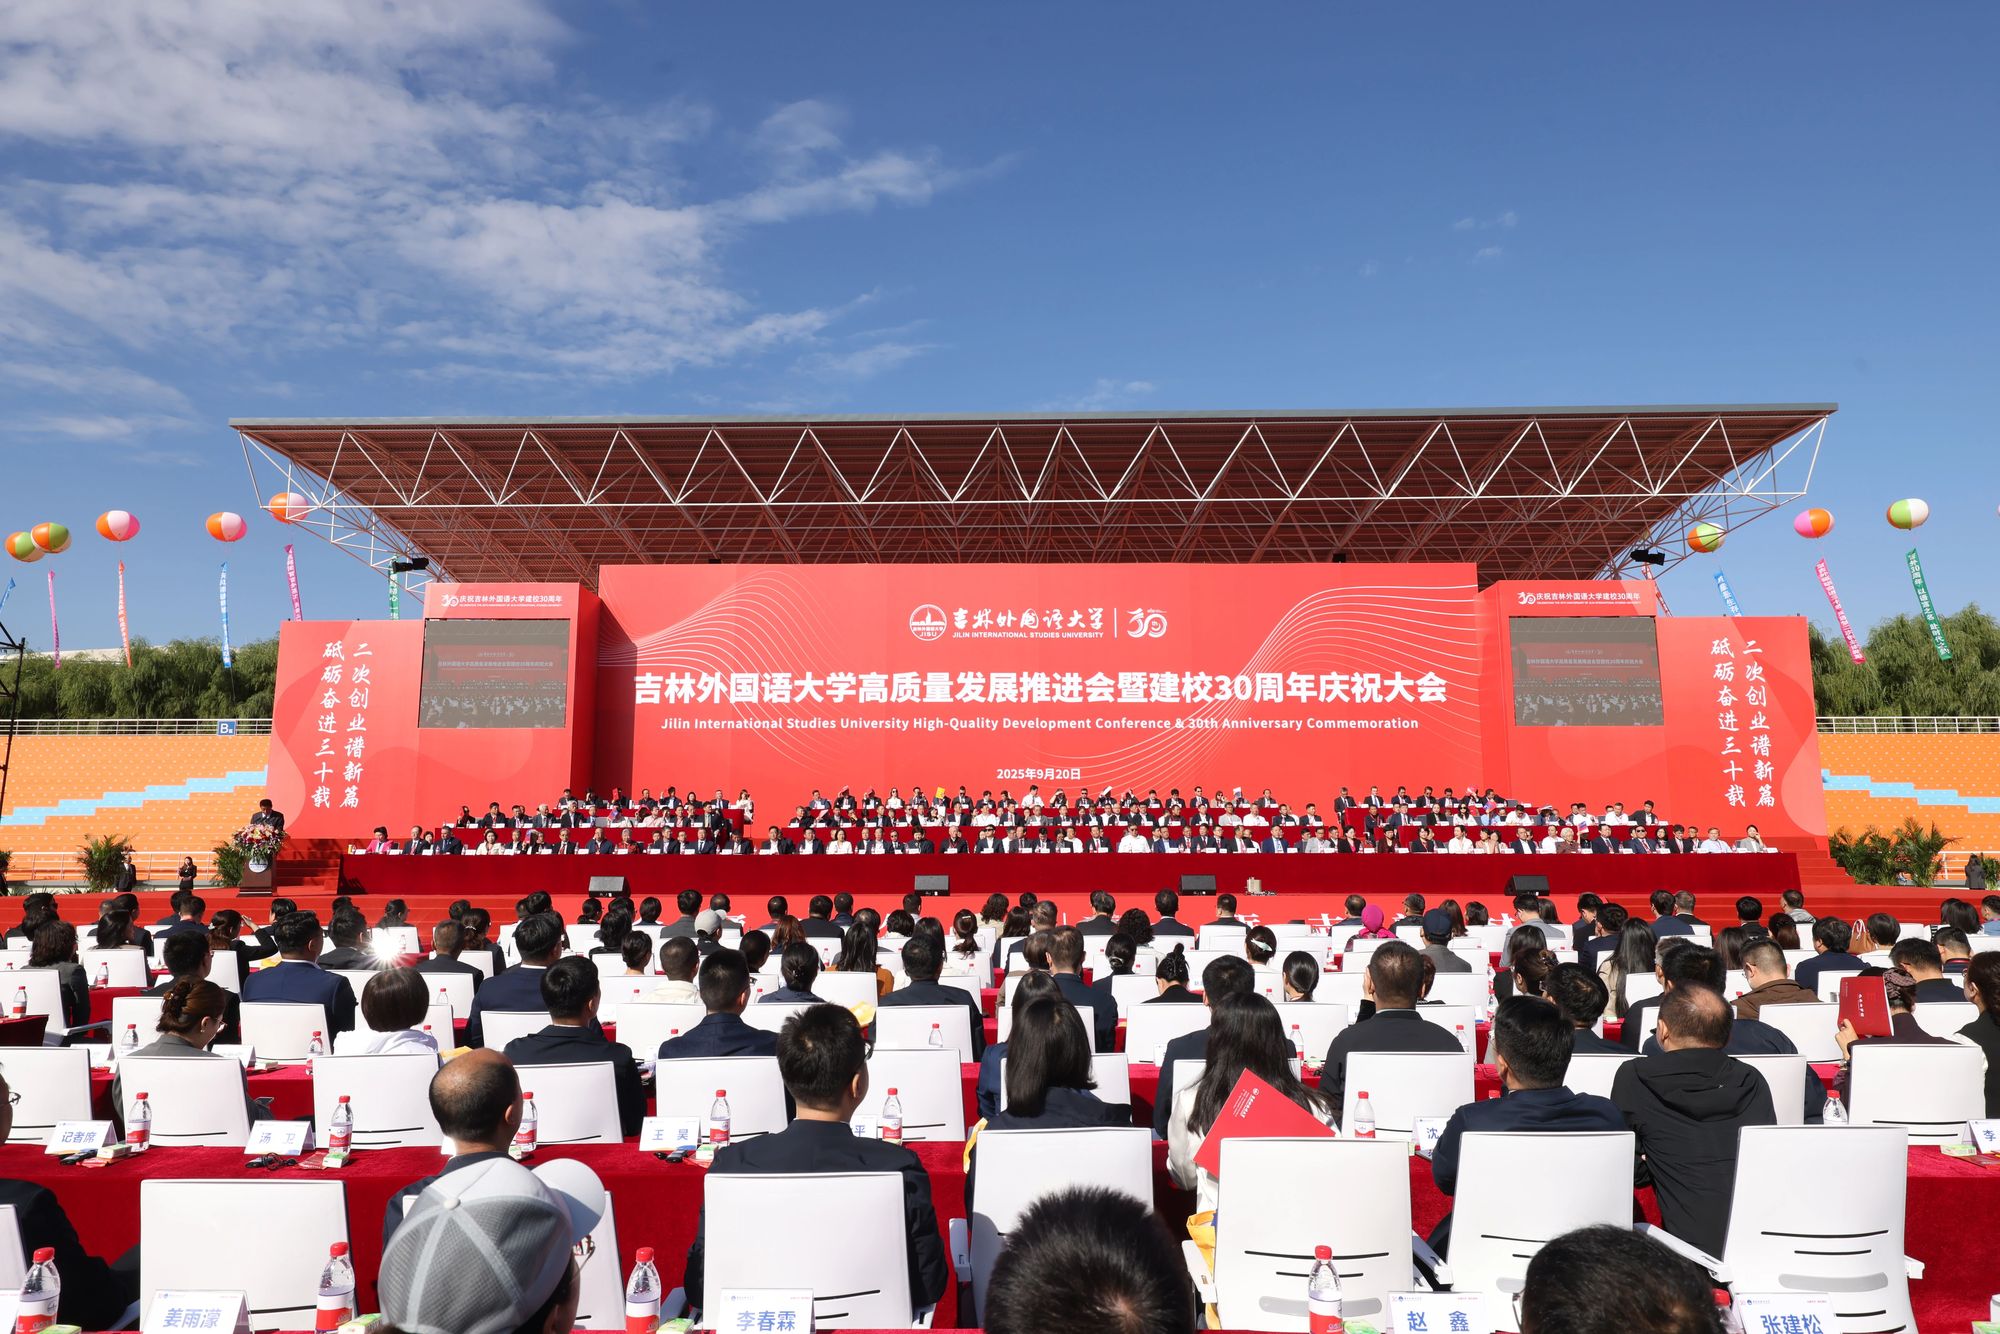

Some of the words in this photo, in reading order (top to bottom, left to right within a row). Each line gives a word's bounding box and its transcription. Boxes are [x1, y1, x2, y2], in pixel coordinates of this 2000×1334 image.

[634, 671, 1448, 704] 吉林外国语大学高质量发展推进会暨建校30周年庆祝大会
[311, 640, 345, 808] 砥砺奋进三十载
[340, 642, 373, 808] 二次创业谱新篇
[661, 717, 690, 730] Jilin
[694, 717, 783, 729] International
[786, 717, 836, 729] Studies
[840, 717, 910, 732] University
[914, 717, 999, 732] High-Quality
[1003, 717, 1092, 732] Development
[1096, 717, 1171, 729] Conference
[1175, 718, 1185, 729] &
[1188, 717, 1218, 729] 30th
[1222, 717, 1303, 732] Anniversary
[1307, 717, 1419, 729] Commemoration
[1710, 637, 1746, 807] 砥砺奋进三十载
[1742, 640, 1775, 808] 二次创业谱新篇
[996, 767, 1081, 780] 2025年9月20日
[61, 1132, 97, 1144] 记者席
[162, 1308, 222, 1328] 姜雨濛
[736, 1310, 796, 1332] 李春霖
[1407, 1311, 1428, 1331] 赵
[1449, 1311, 1470, 1332] 鑫
[1760, 1314, 1824, 1334] 张建松
